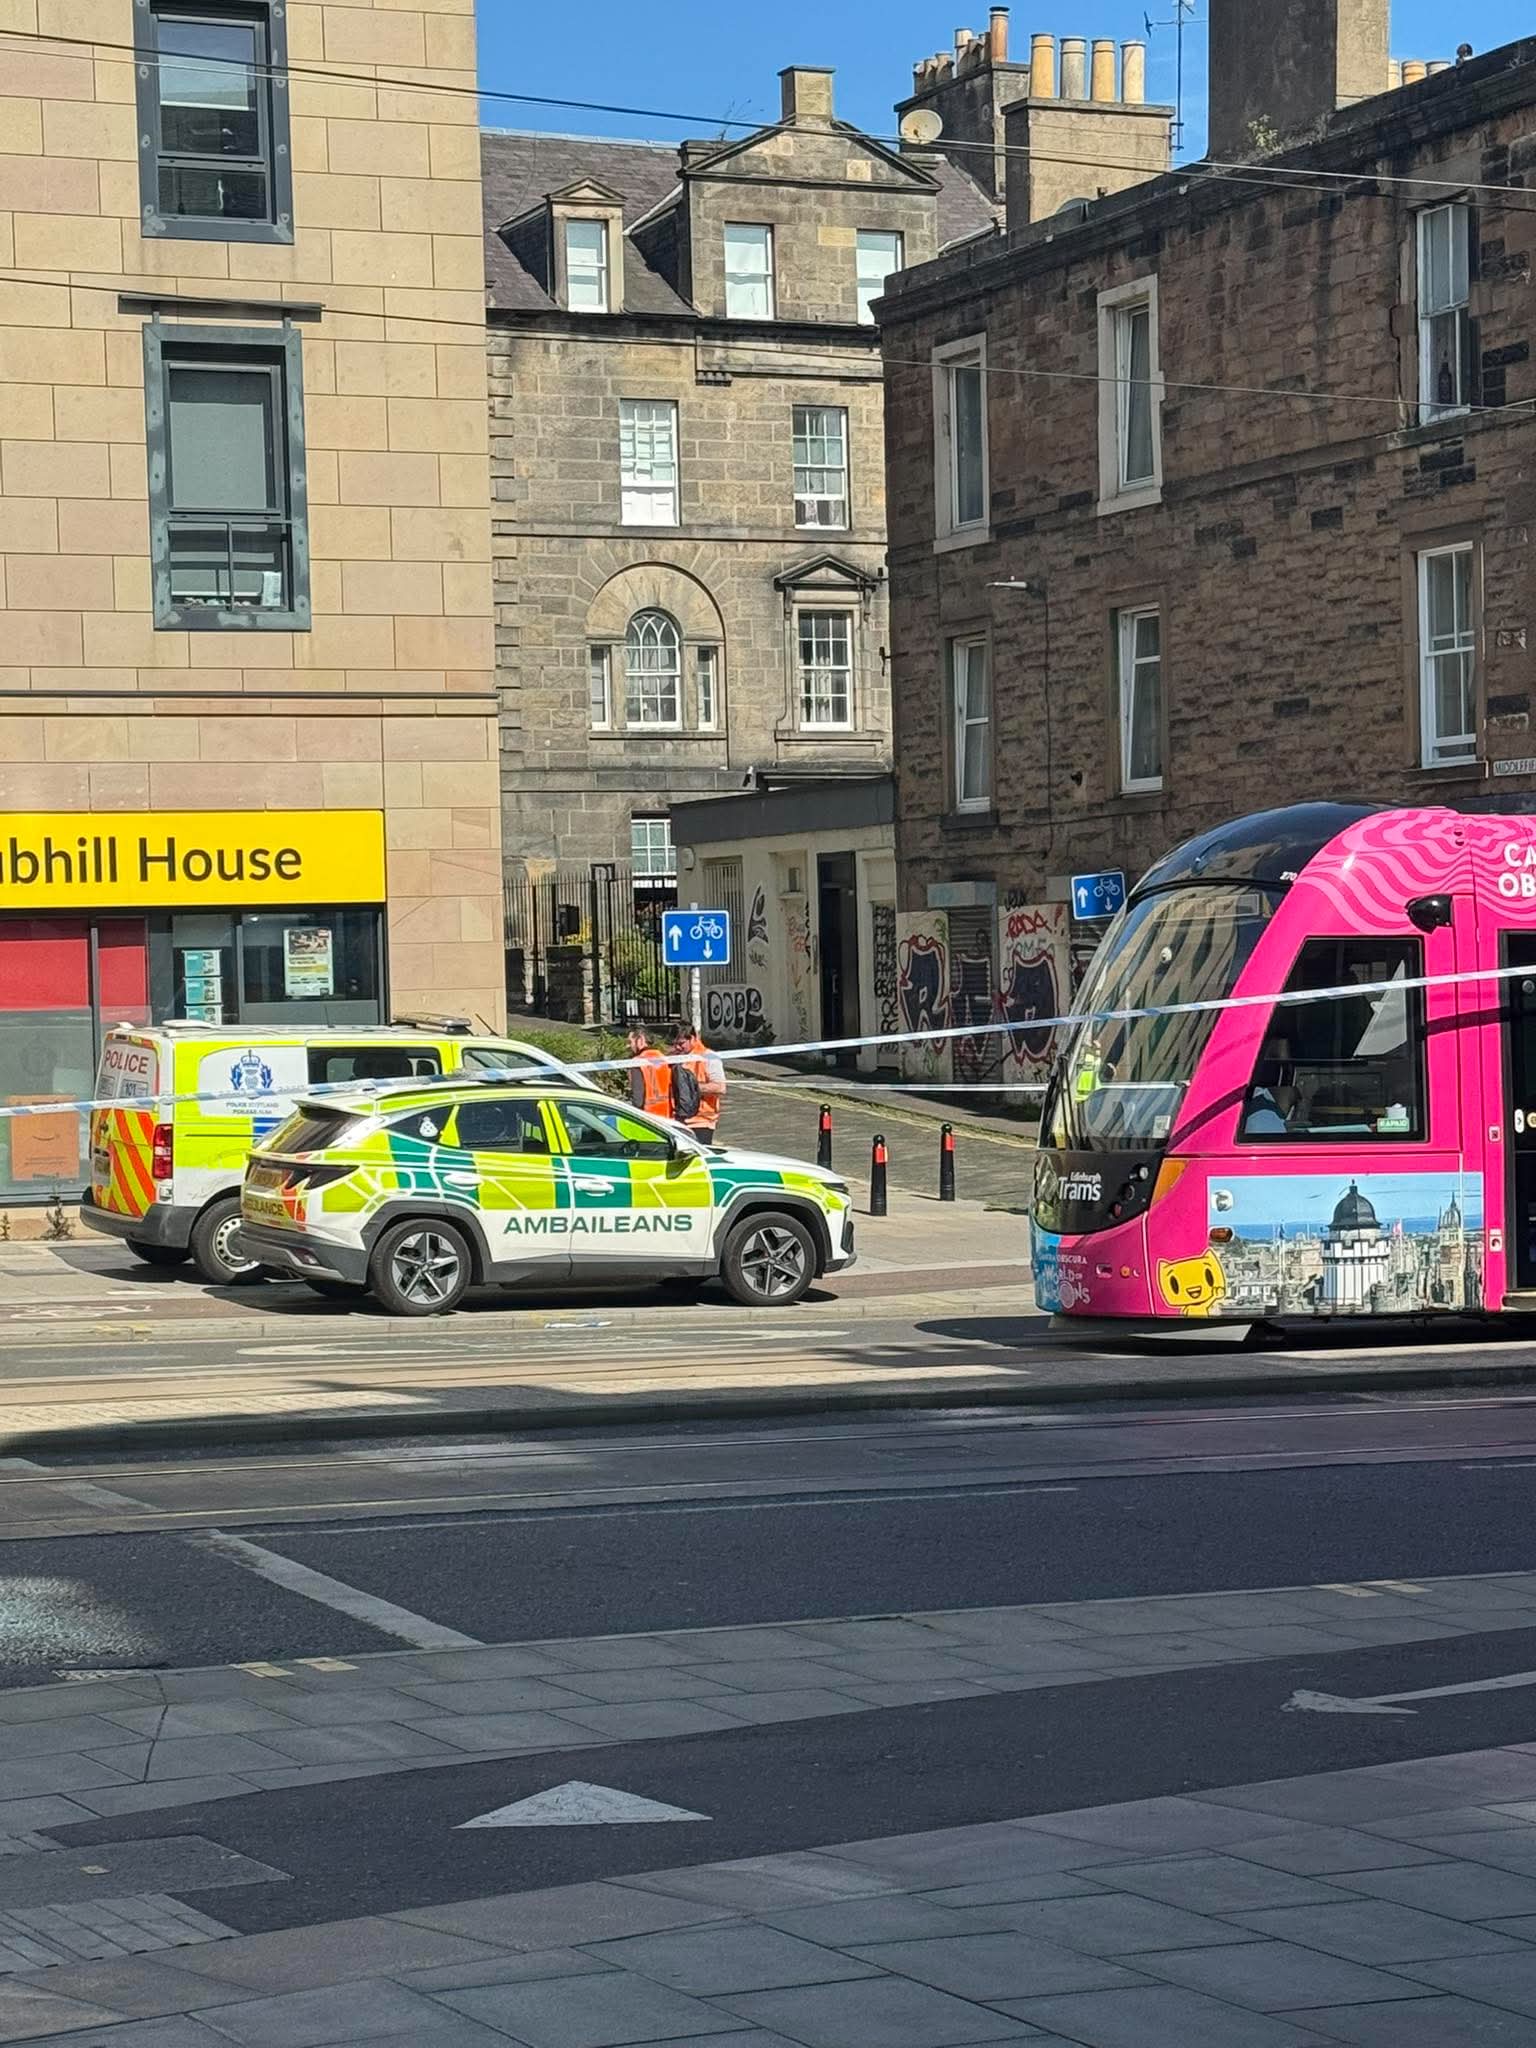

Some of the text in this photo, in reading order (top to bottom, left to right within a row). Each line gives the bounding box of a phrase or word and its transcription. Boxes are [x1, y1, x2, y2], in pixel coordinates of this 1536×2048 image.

[0, 836, 303, 884] bhill House
[1498, 872, 1536, 898] OB
[105, 1050, 149, 1075] POLICE
[1058, 1176, 1102, 1201] Trams
[503, 1214, 693, 1234] AMBAILEANS
